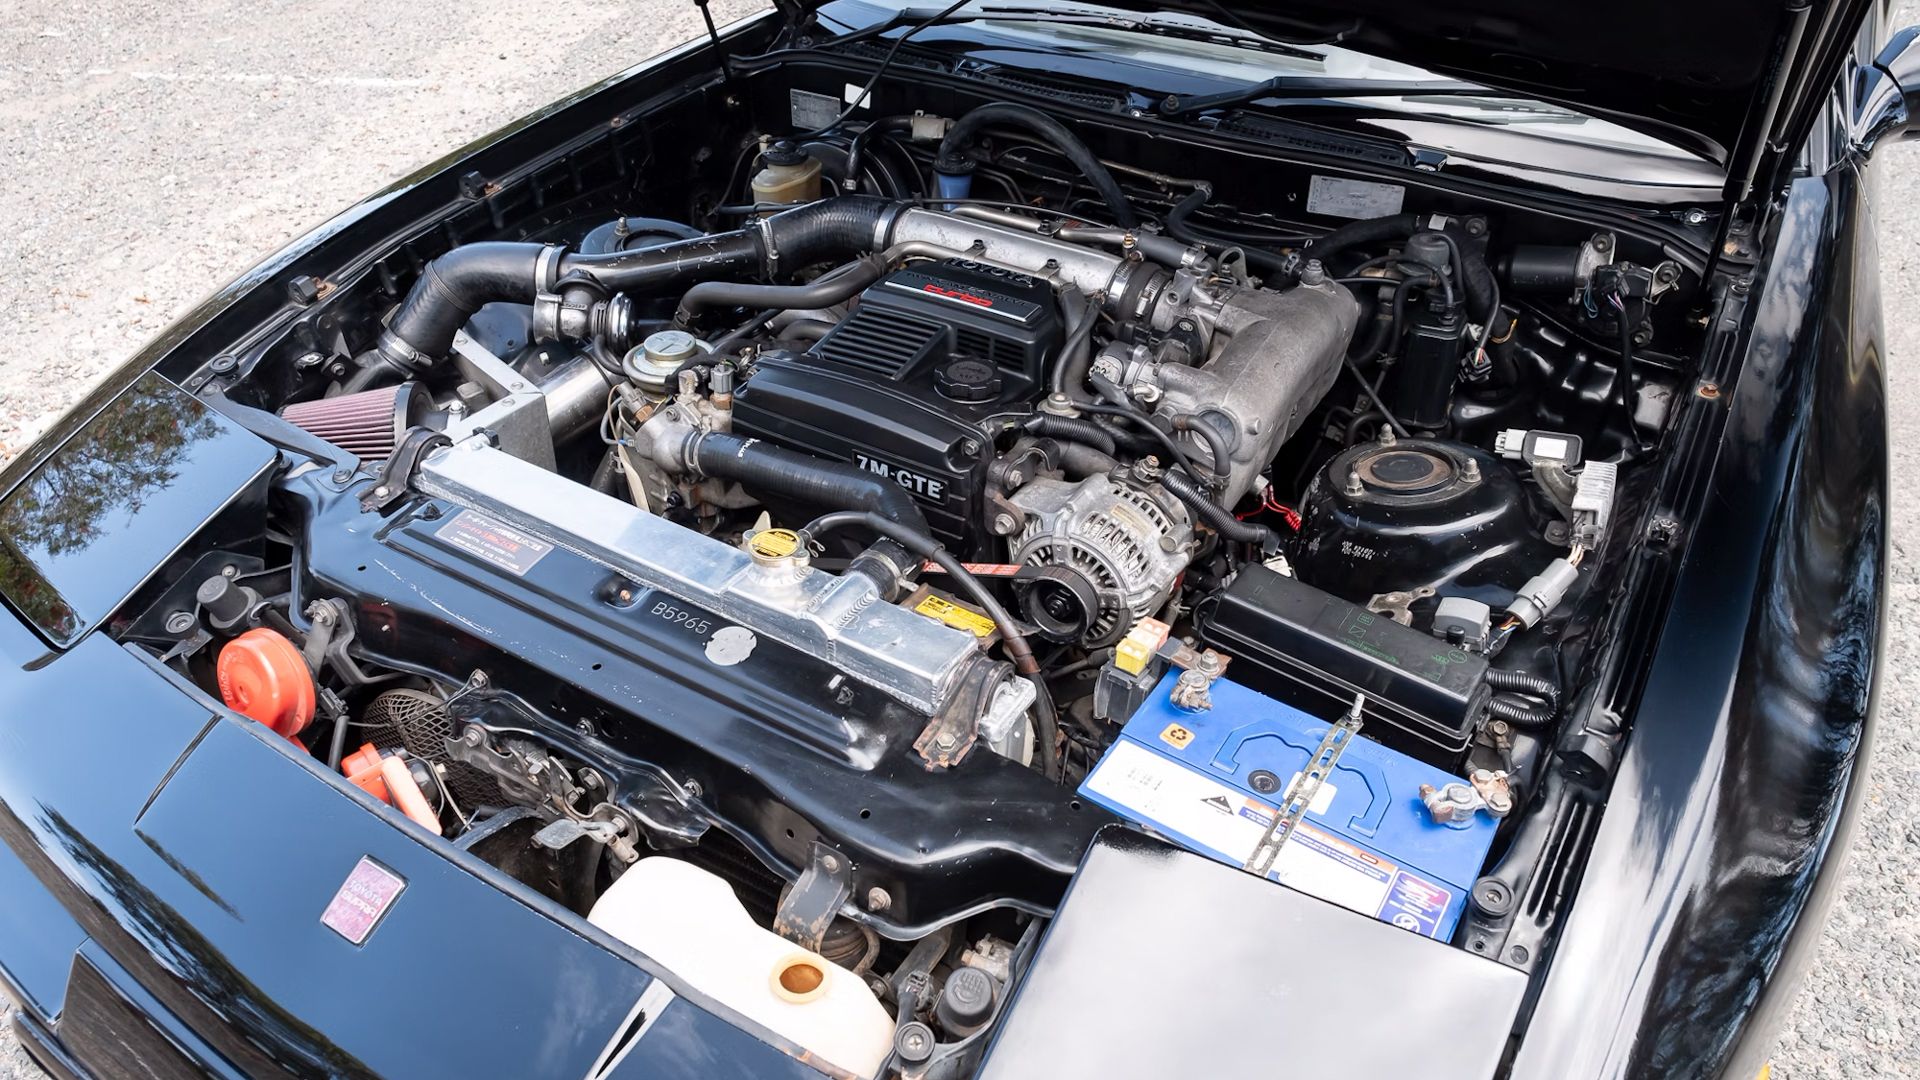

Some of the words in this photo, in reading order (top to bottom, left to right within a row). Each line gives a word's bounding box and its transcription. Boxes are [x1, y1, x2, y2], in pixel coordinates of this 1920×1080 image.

[857, 455, 942, 499] 7M-GTE
[651, 601, 712, 634] B5965
[340, 890, 377, 918] SUPRA
[349, 881, 382, 905] TOYOTA
